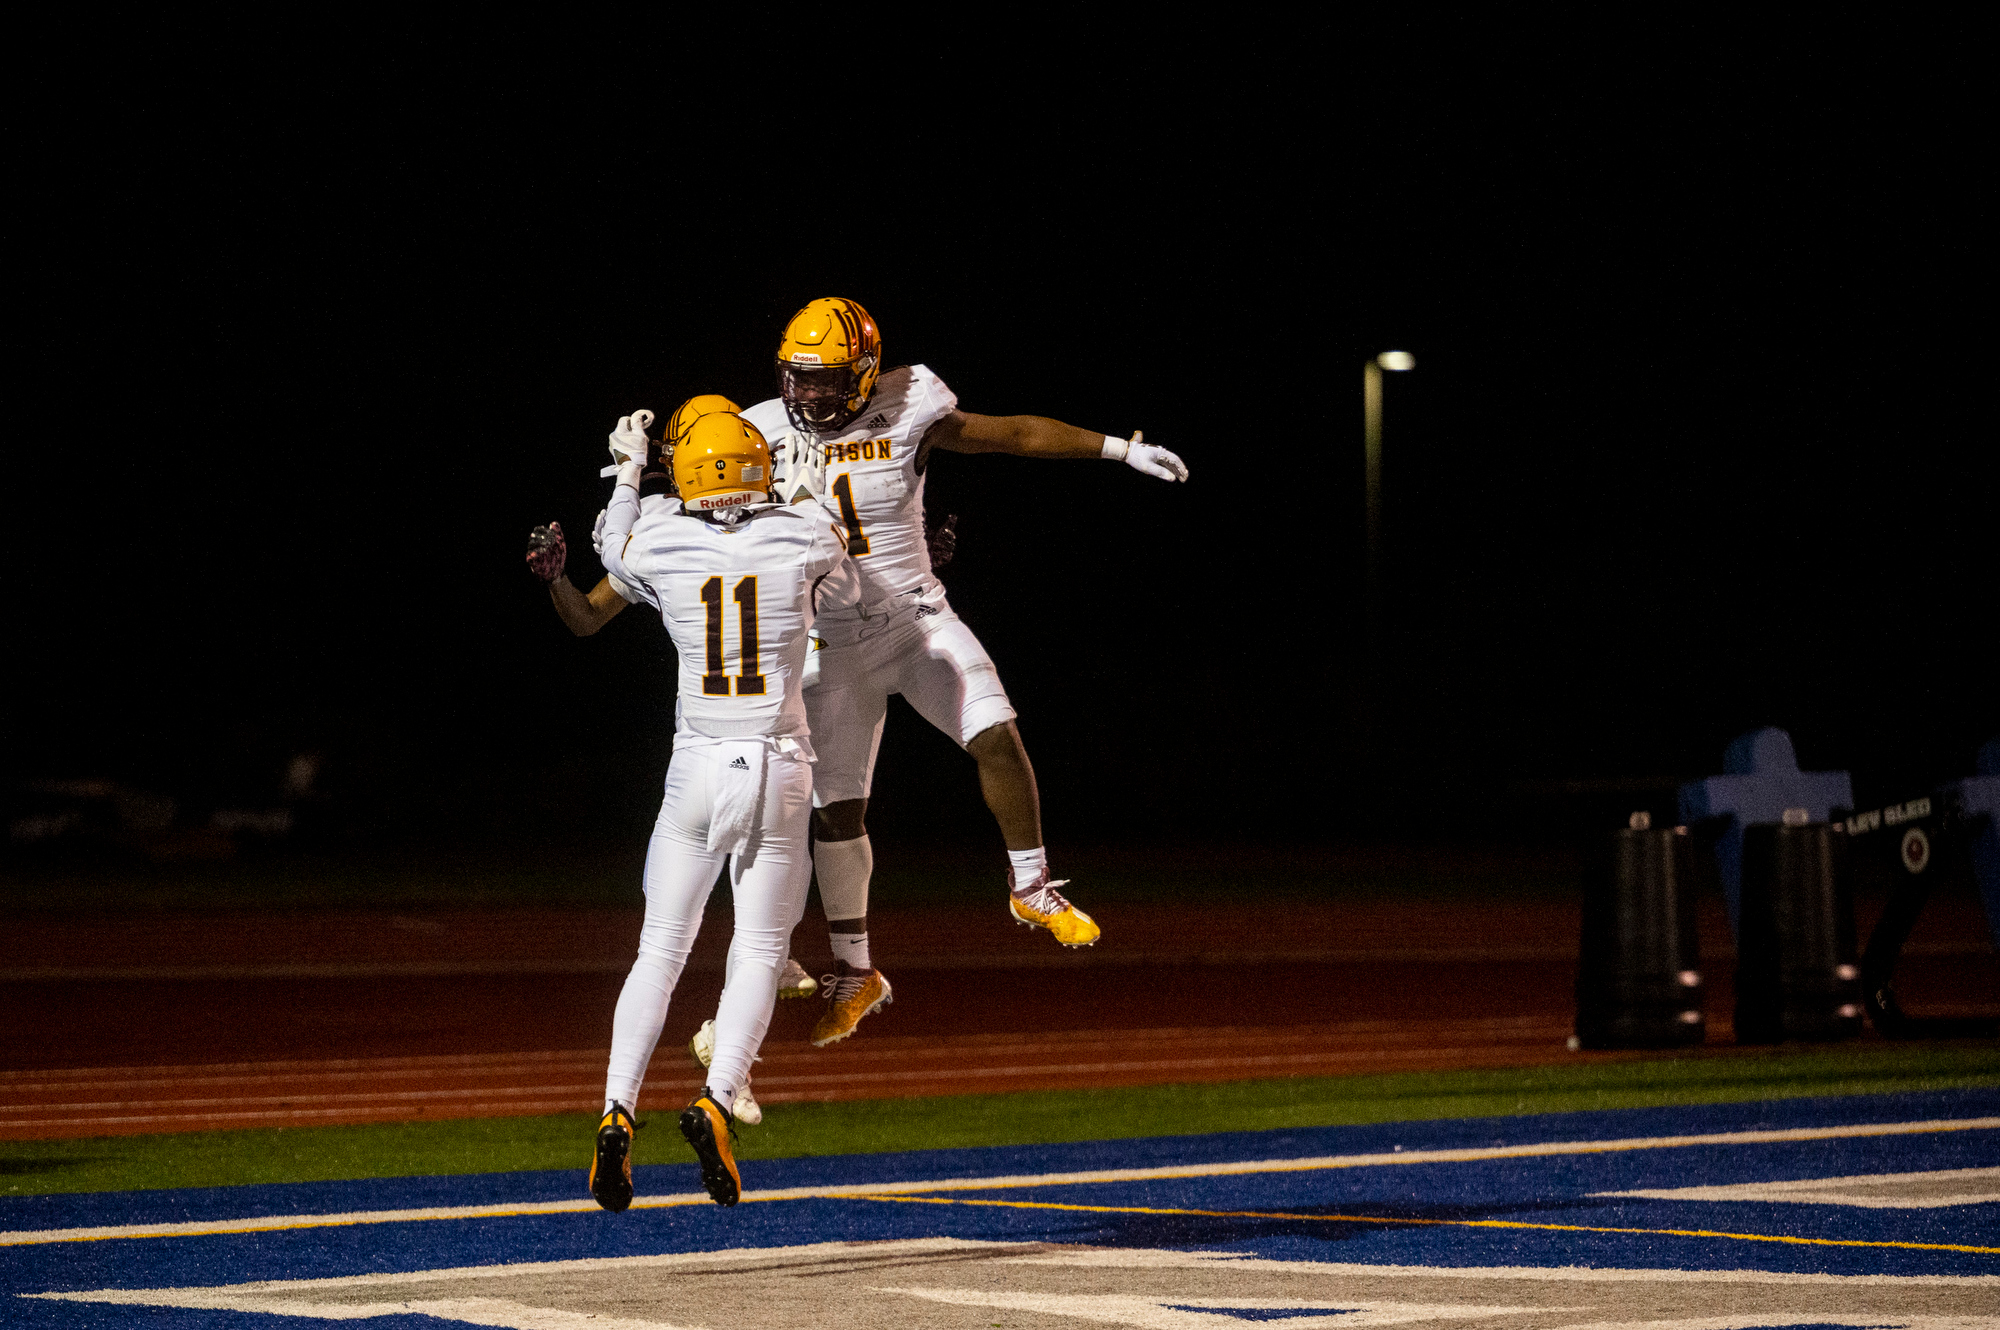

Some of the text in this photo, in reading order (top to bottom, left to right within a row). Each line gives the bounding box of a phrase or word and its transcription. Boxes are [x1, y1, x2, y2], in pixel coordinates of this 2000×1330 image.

[793, 354, 818, 363] Riddell
[716, 461, 725, 469] 11
[700, 493, 752, 509] Riddell
[700, 575, 767, 697] 11
[728, 763, 750, 771] adidas
